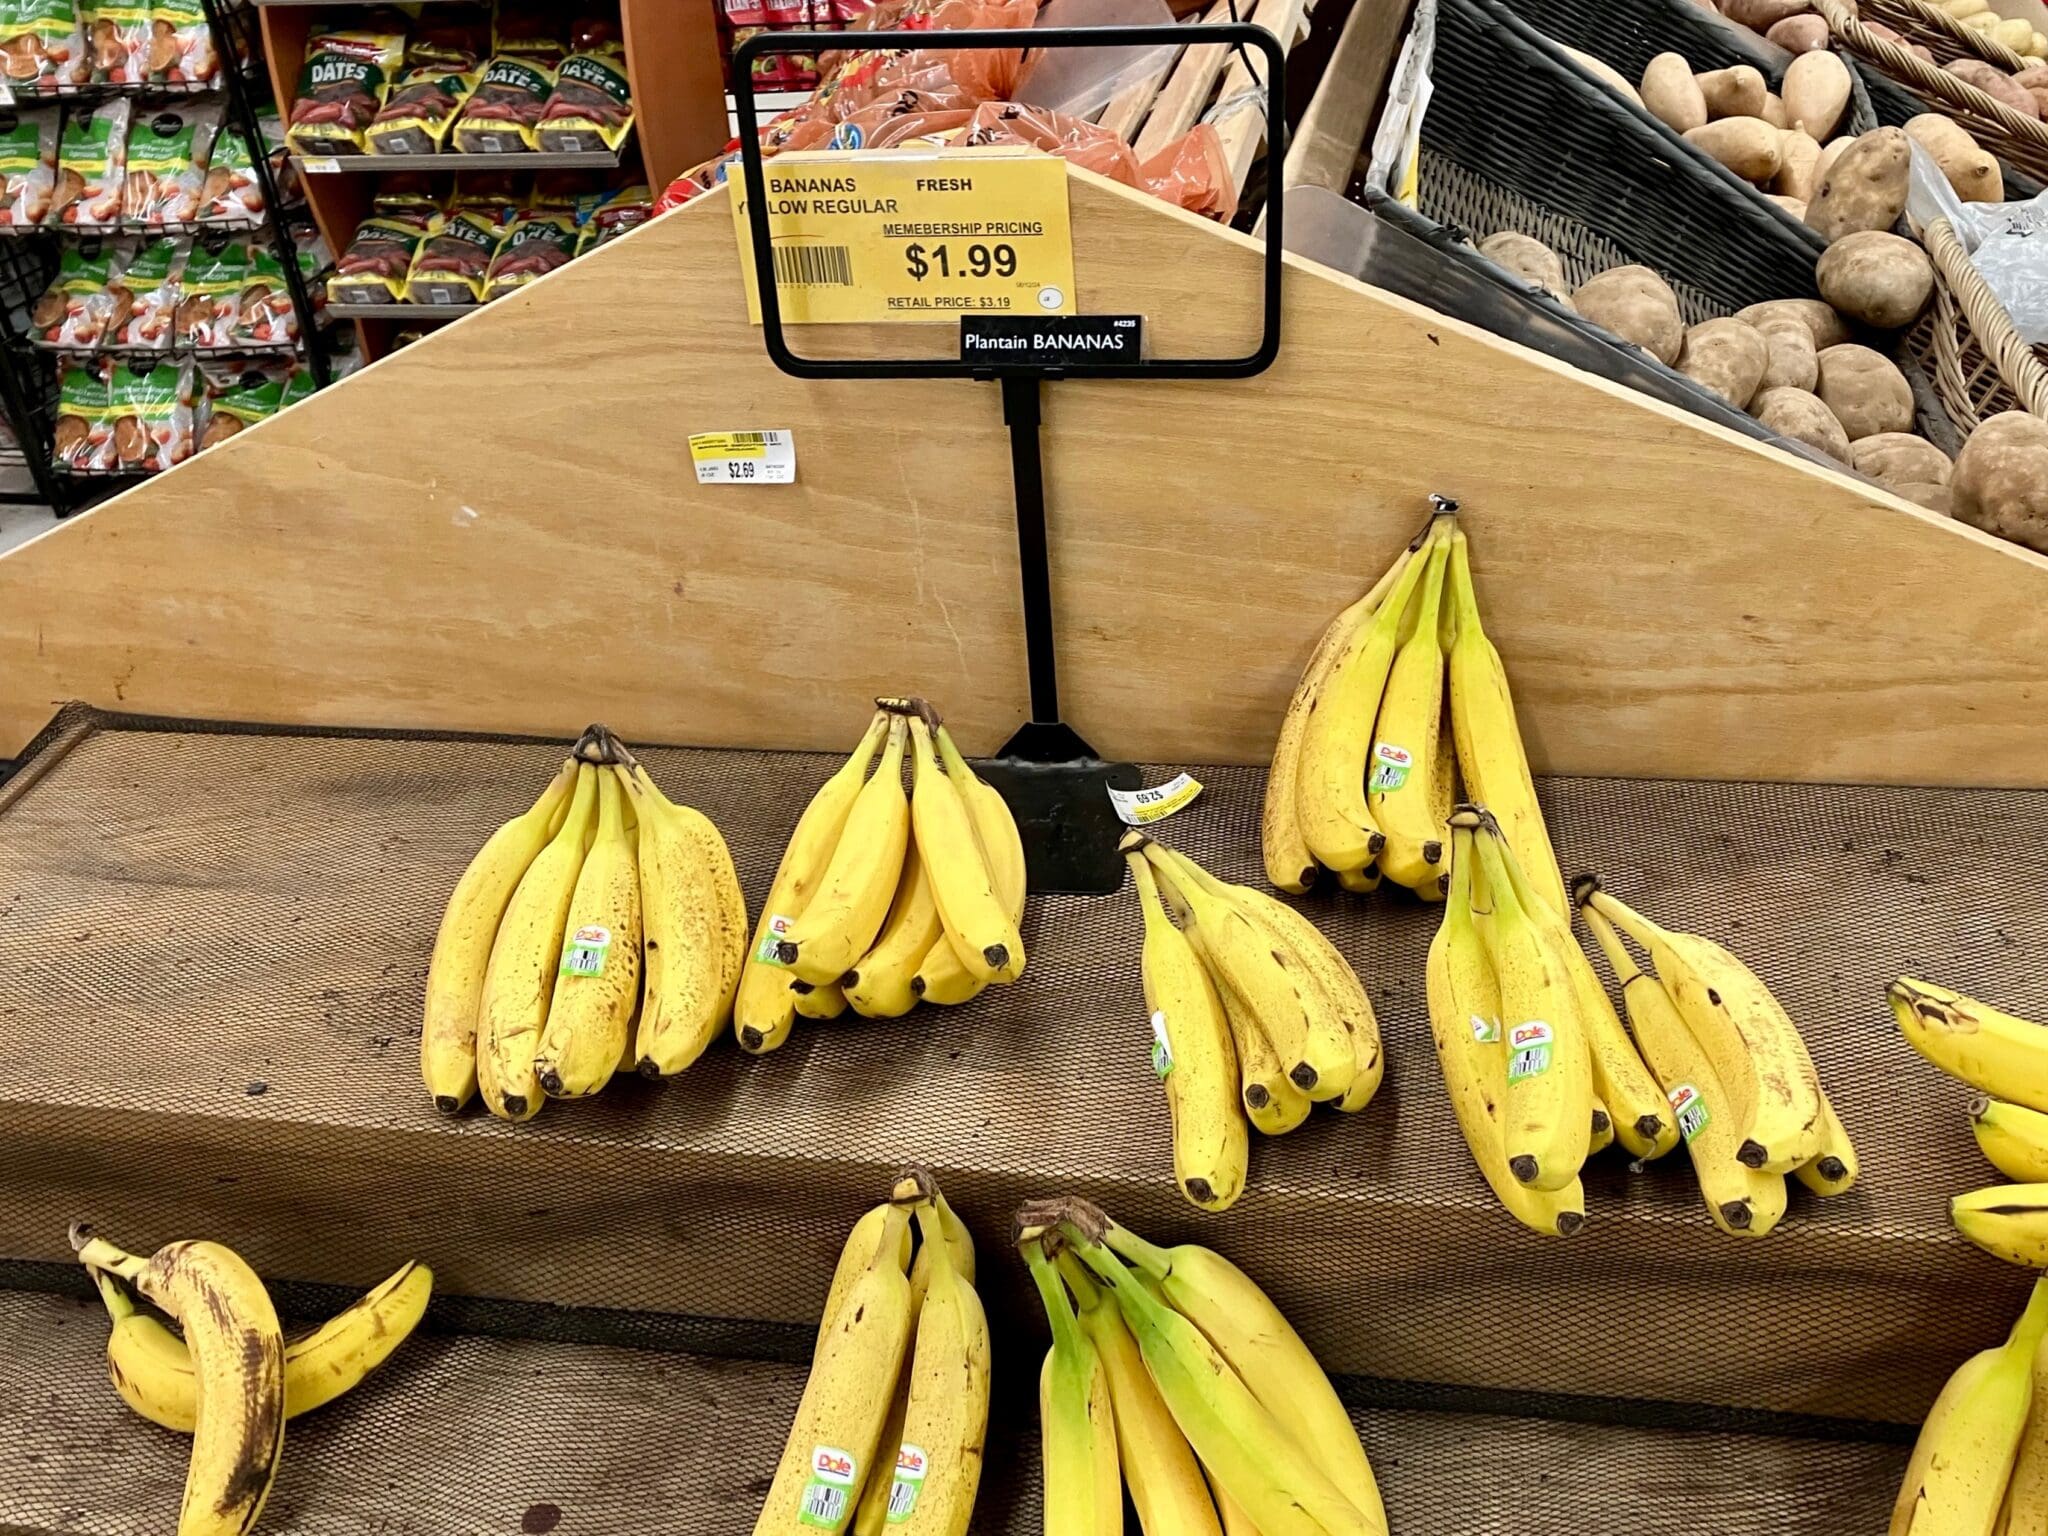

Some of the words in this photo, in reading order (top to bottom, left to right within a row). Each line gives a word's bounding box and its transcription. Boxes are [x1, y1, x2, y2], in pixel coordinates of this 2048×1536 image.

[311, 61, 369, 84] DATES
[770, 177, 857, 193] BANANAS
[916, 178, 973, 192] FRESH
[737, 199, 808, 215] YLOW
[813, 199, 899, 214] REGULAR
[444, 222, 490, 246] ATES
[882, 222, 983, 236] MEMEBERSHIP
[986, 221, 1043, 235] PRICING
[905, 242, 1017, 282] $1.99
[887, 296, 931, 308] RETAIL
[935, 296, 976, 308] PRICE:
[979, 295, 1011, 308] $3.19
[965, 333, 1028, 349] Plantain
[1032, 333, 1124, 350] BANANAS
[728, 461, 755, 479] $2.69
[818, 1454, 852, 1474] Dole
